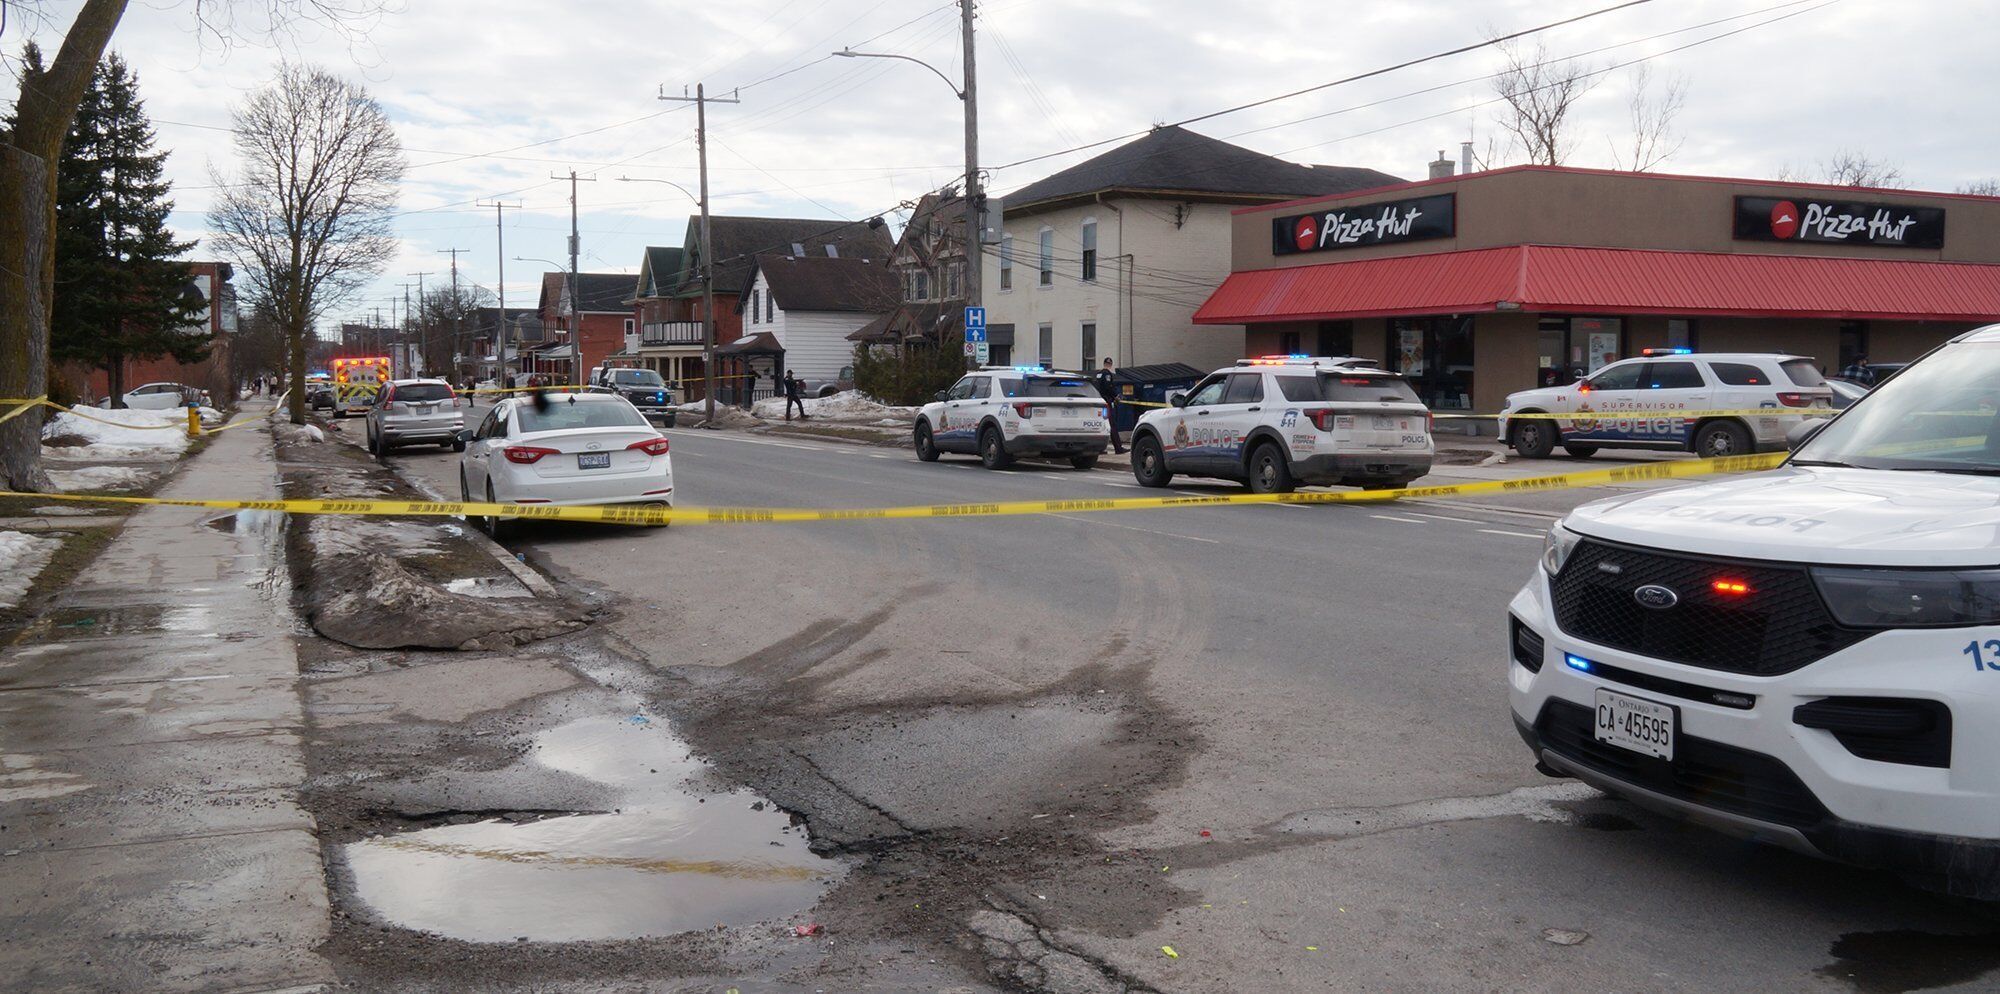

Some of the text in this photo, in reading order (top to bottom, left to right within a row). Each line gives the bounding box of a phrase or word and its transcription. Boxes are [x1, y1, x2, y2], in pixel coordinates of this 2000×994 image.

[1320, 206, 1422, 247] Pizza Hut
[1800, 203, 1917, 240] Pizza Hut
[969, 310, 982, 326] H
[1601, 416, 1685, 434] POLICE
[1192, 428, 1241, 449] POLICE
[1402, 436, 1426, 444] POLICE
[1642, 588, 1666, 604] Ford
[1963, 639, 2000, 671] 13
[1598, 704, 1614, 732] CA
[1624, 711, 1669, 746] 45595
